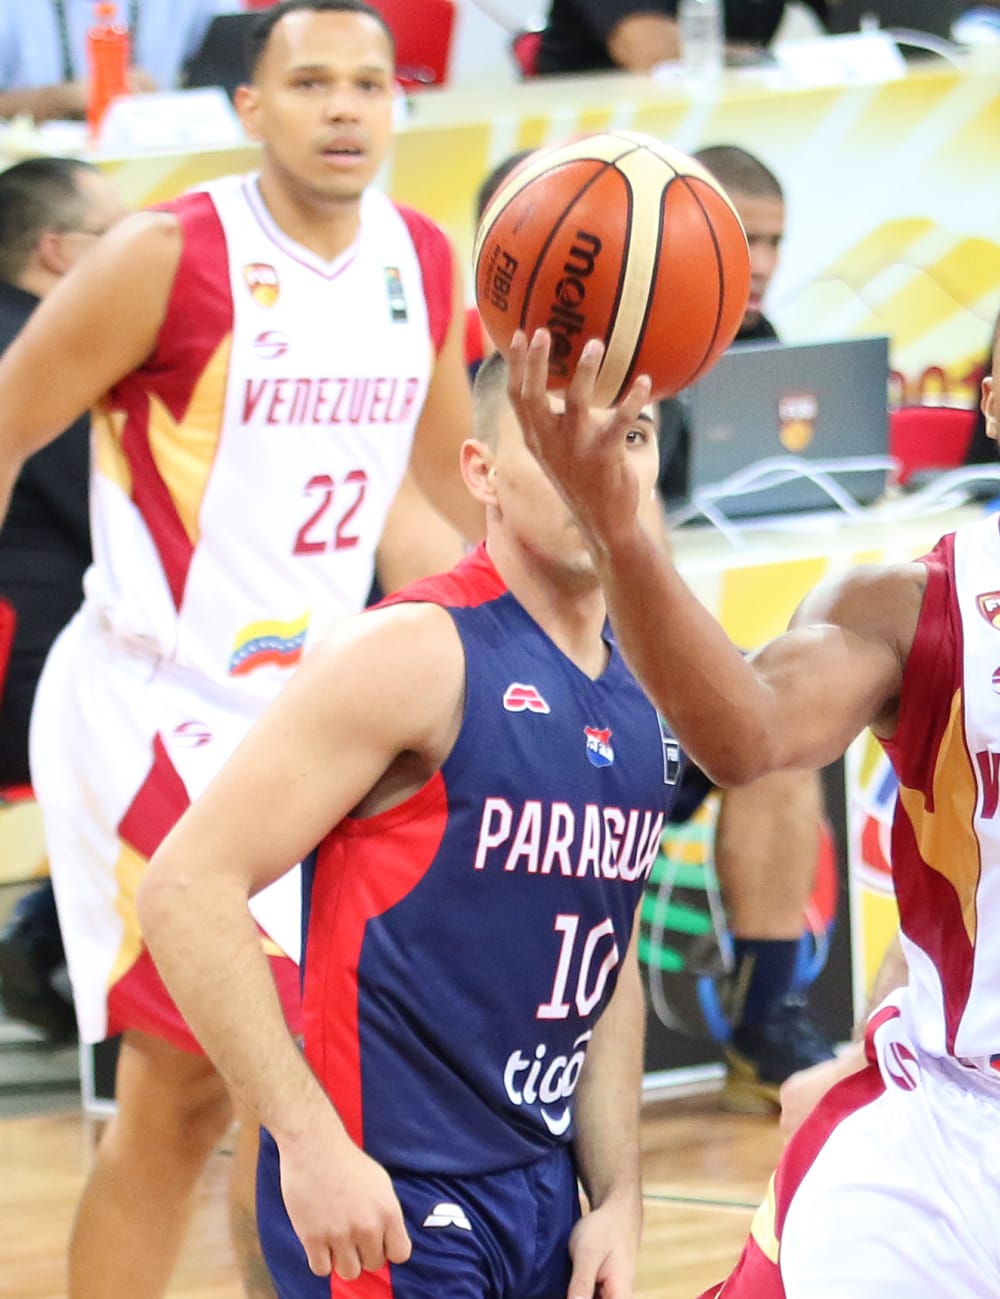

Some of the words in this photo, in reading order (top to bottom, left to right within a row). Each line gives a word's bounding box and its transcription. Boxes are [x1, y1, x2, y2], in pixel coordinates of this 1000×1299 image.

[491, 250, 520, 313] FIBA
[240, 376, 420, 427] VENEZUELA
[292, 469, 368, 557] 22
[536, 914, 620, 1019] 10
